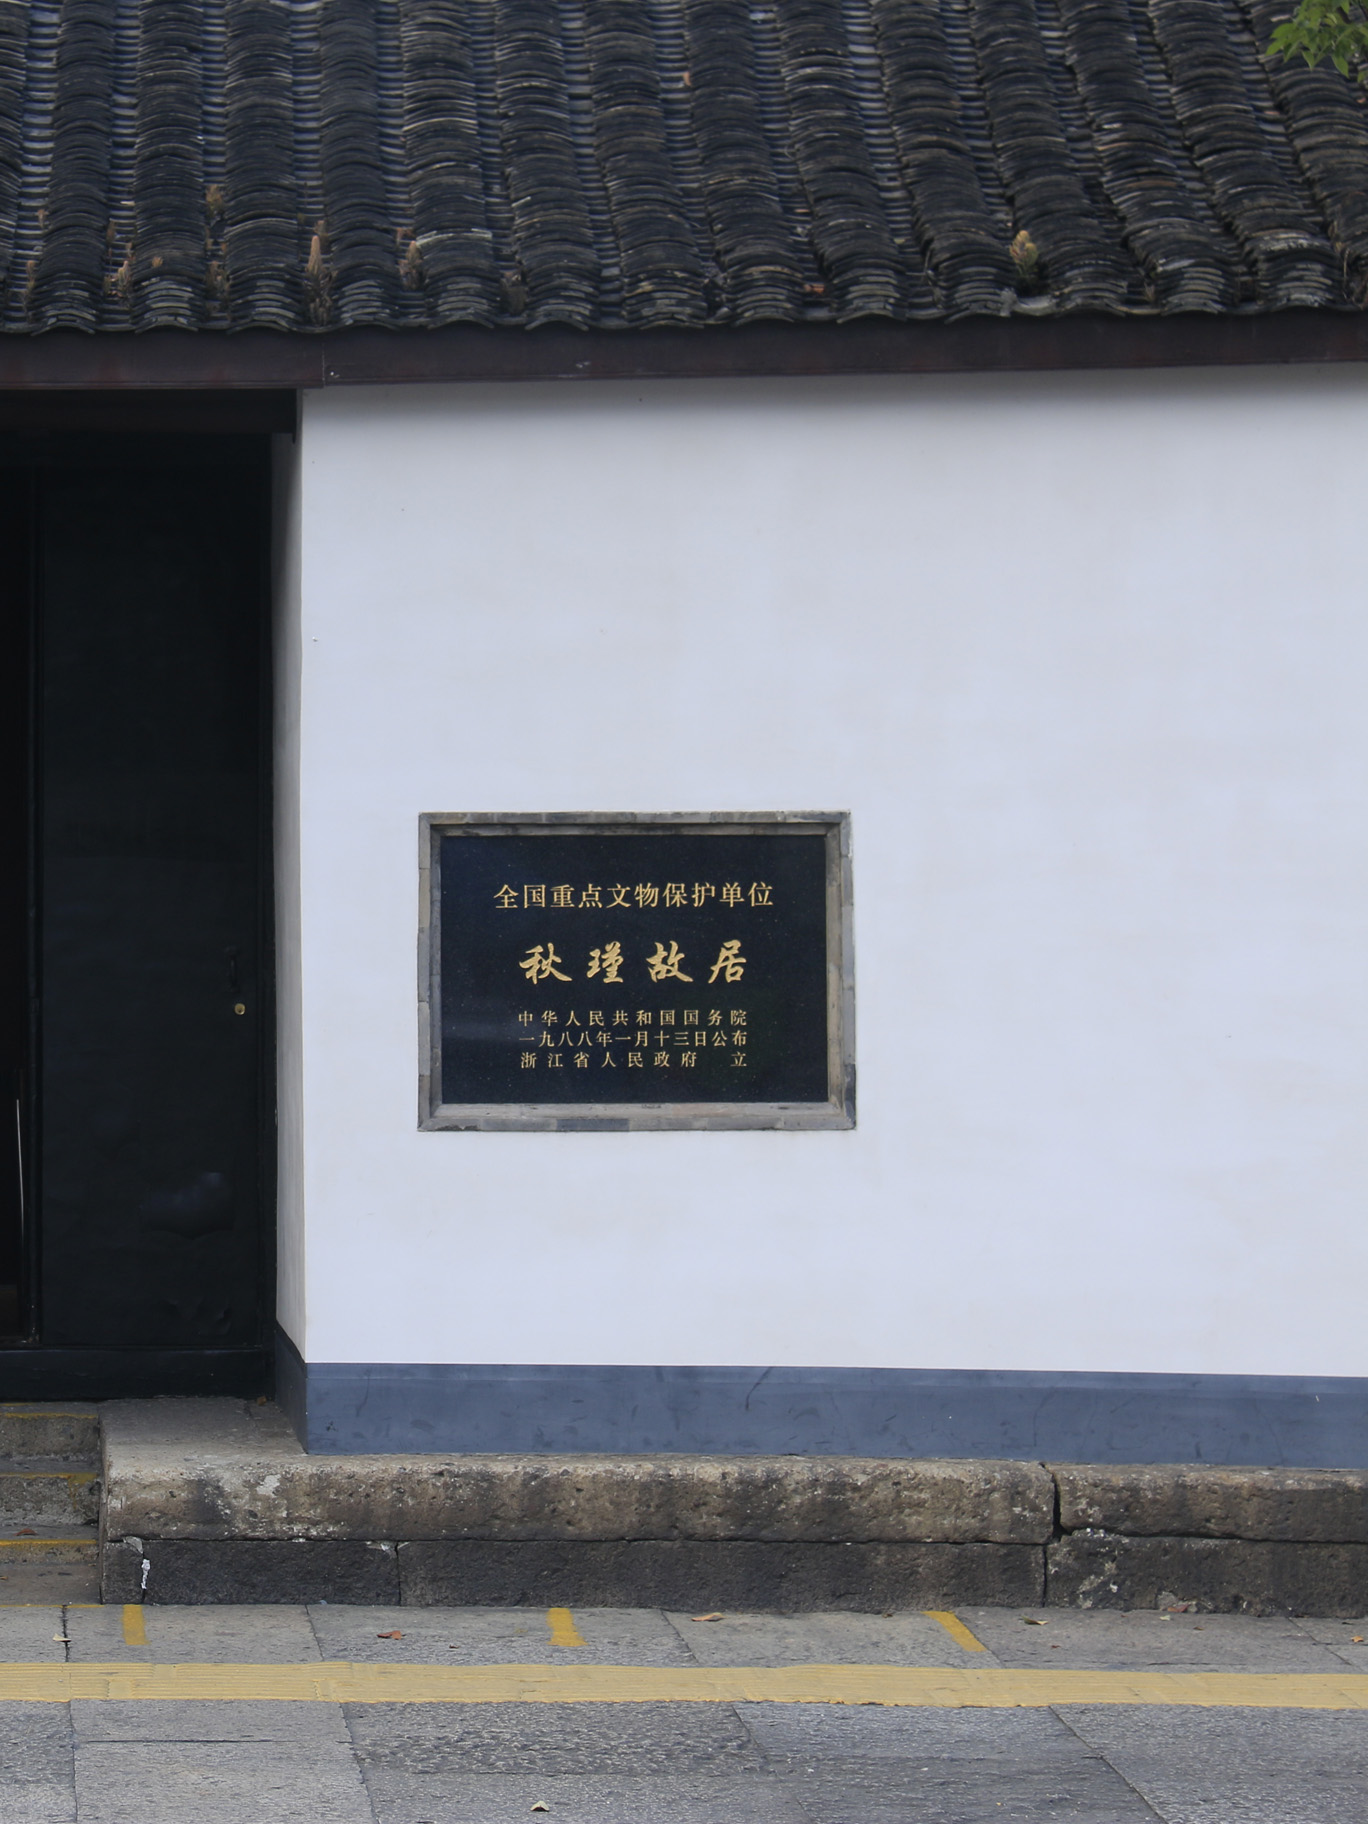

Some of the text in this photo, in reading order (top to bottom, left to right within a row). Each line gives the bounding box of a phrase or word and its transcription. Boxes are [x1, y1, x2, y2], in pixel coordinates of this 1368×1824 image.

[492, 881, 774, 910] 全国重点文物保护单位
[517, 938, 748, 986] 秋瑾故居
[517, 1008, 748, 1027] 中华人民共和国国务院
[517, 1029, 748, 1048] 一九八八年一月十三日公布
